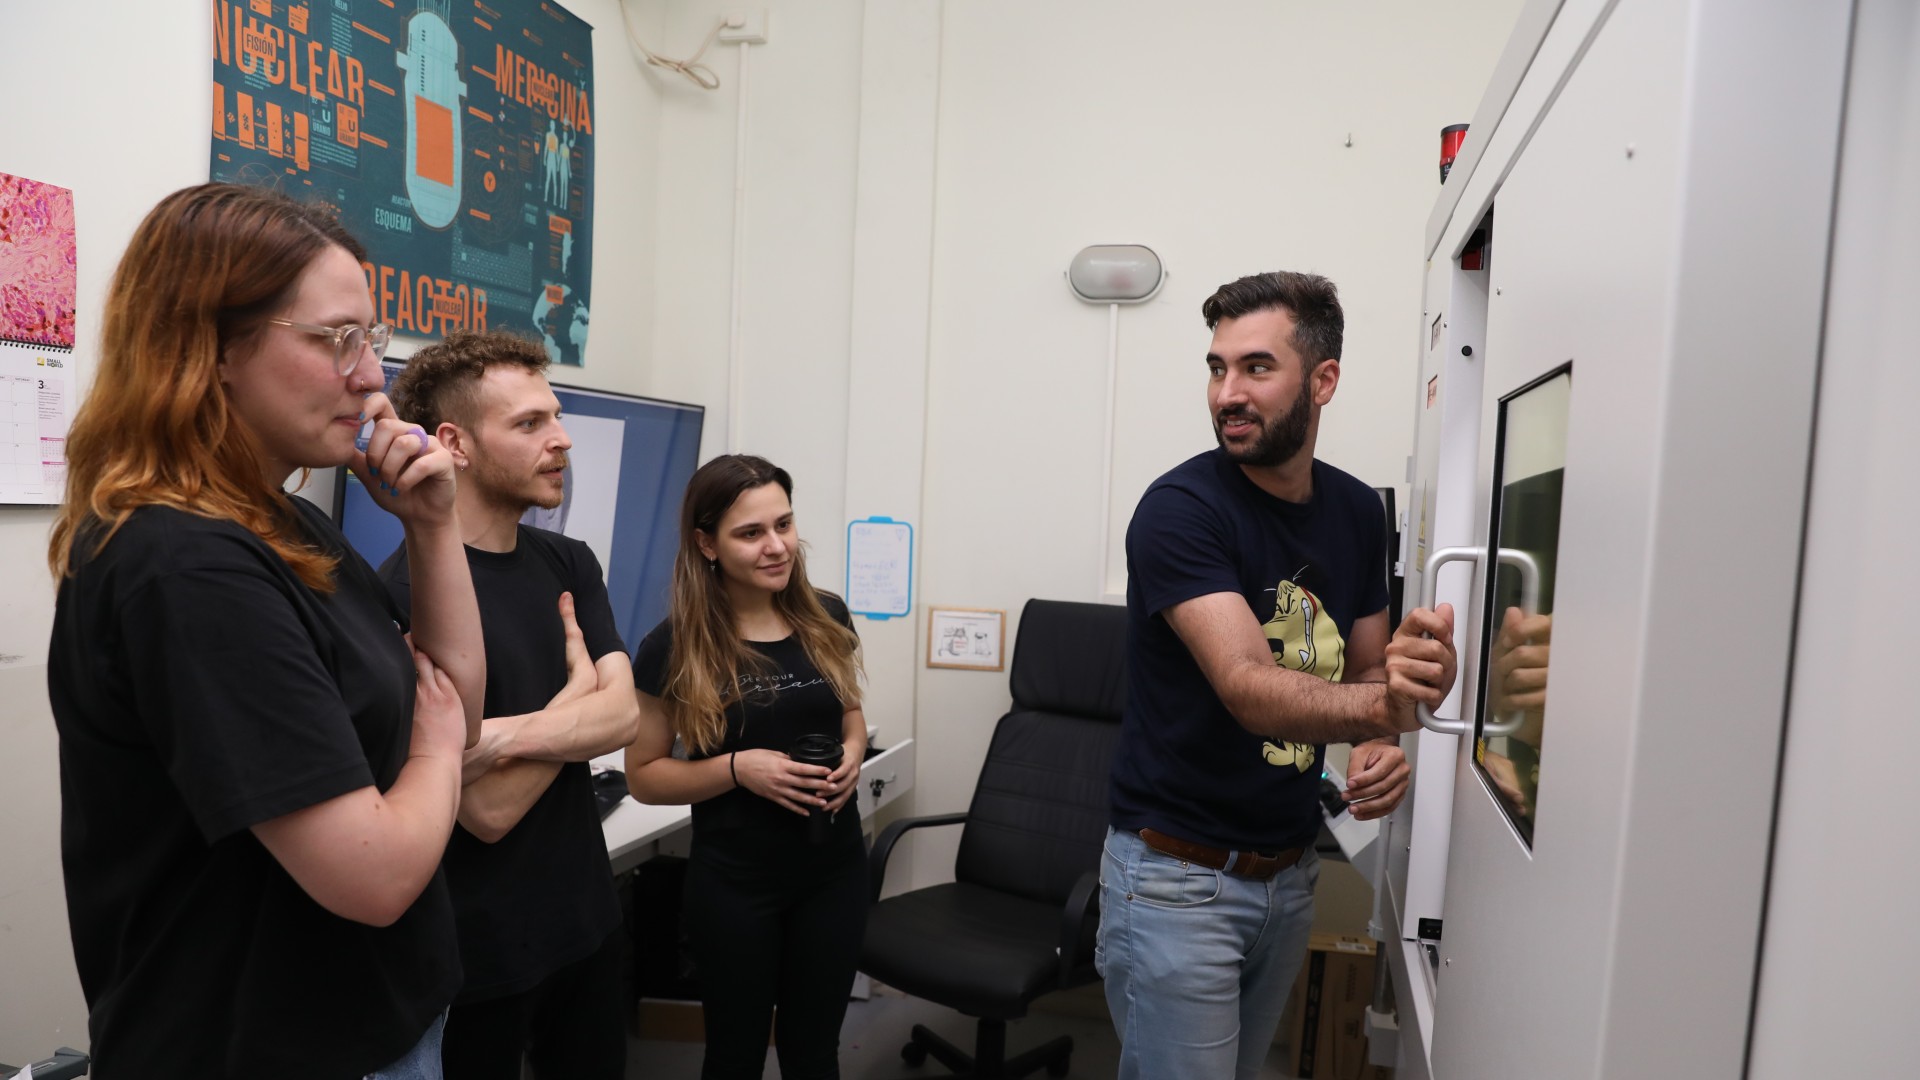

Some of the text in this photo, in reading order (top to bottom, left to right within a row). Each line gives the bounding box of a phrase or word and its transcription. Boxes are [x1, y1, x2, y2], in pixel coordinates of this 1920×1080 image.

[246, 33, 274, 57] FISIÓN
[213, 0, 365, 118] NUCLEAR
[495, 43, 592, 135] MEDICINA
[374, 207, 412, 234] ESQUEMA
[361, 261, 488, 337] REACTOR
[435, 299, 462, 317] NUCLEAR
[38, 379, 45, 390] 3
